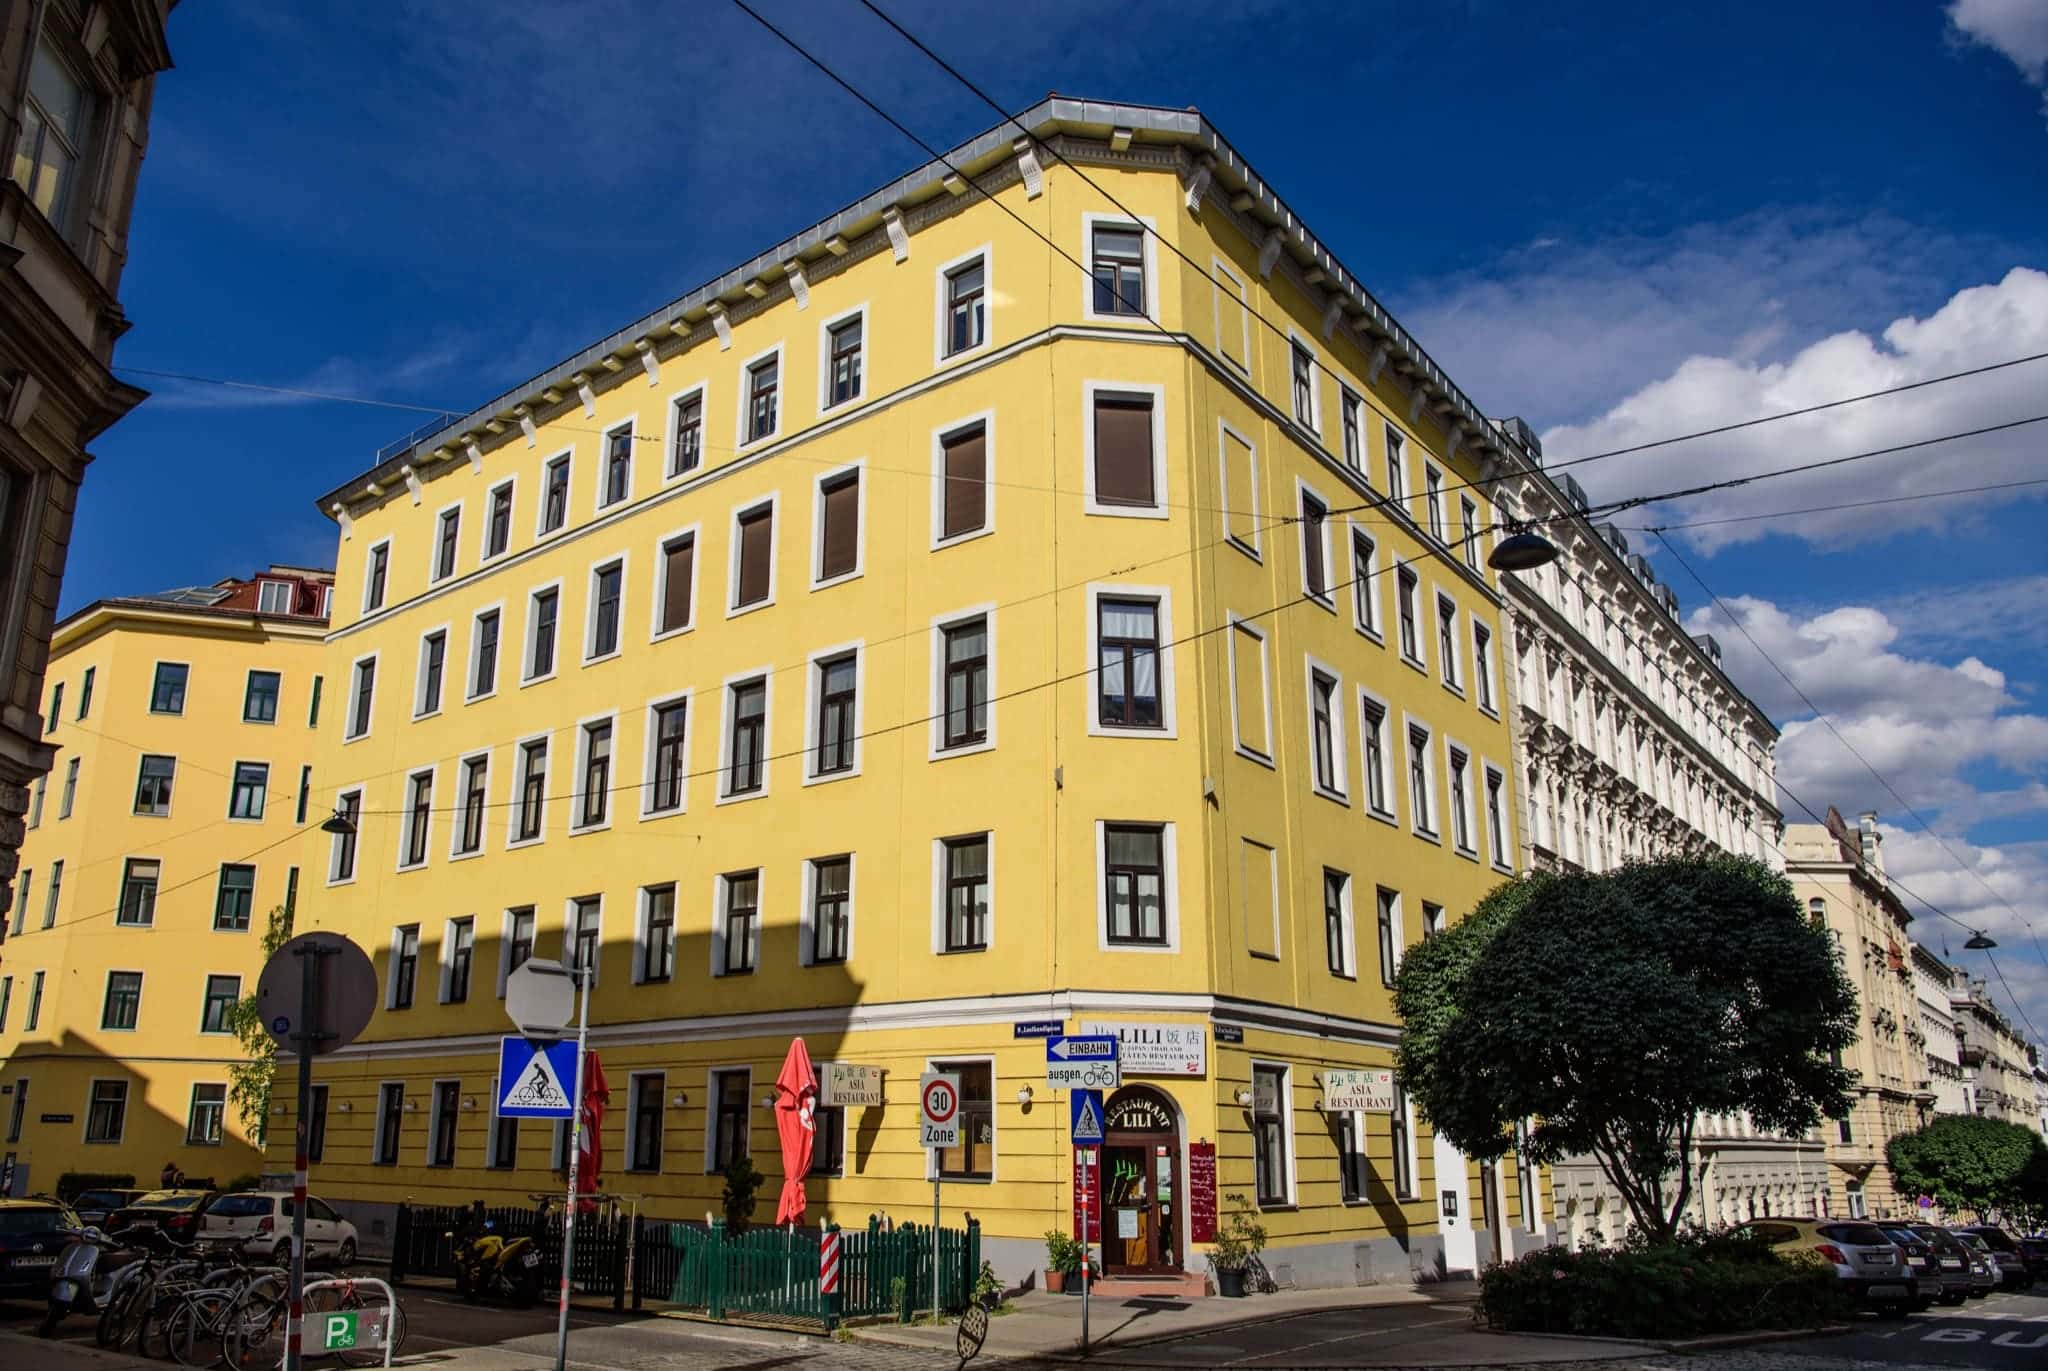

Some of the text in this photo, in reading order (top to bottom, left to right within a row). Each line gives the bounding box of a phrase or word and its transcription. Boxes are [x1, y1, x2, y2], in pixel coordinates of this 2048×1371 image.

[1120, 1029, 1160, 1044] LILI
[1069, 1042, 1109, 1054] EINBAHN
[1048, 1070, 1083, 1082] ausgen.
[849, 1080, 865, 1090] ASIA
[1351, 1084, 1372, 1095] ASIA
[833, 1092, 880, 1104] RESTAURANT
[932, 1092, 948, 1110] 30
[1331, 1097, 1392, 1108] RESTAURANT
[1104, 1098, 1170, 1127] RESTAURANT
[1123, 1113, 1152, 1127] LILI
[926, 1125, 954, 1142] Zone
[326, 1317, 348, 1347] P
